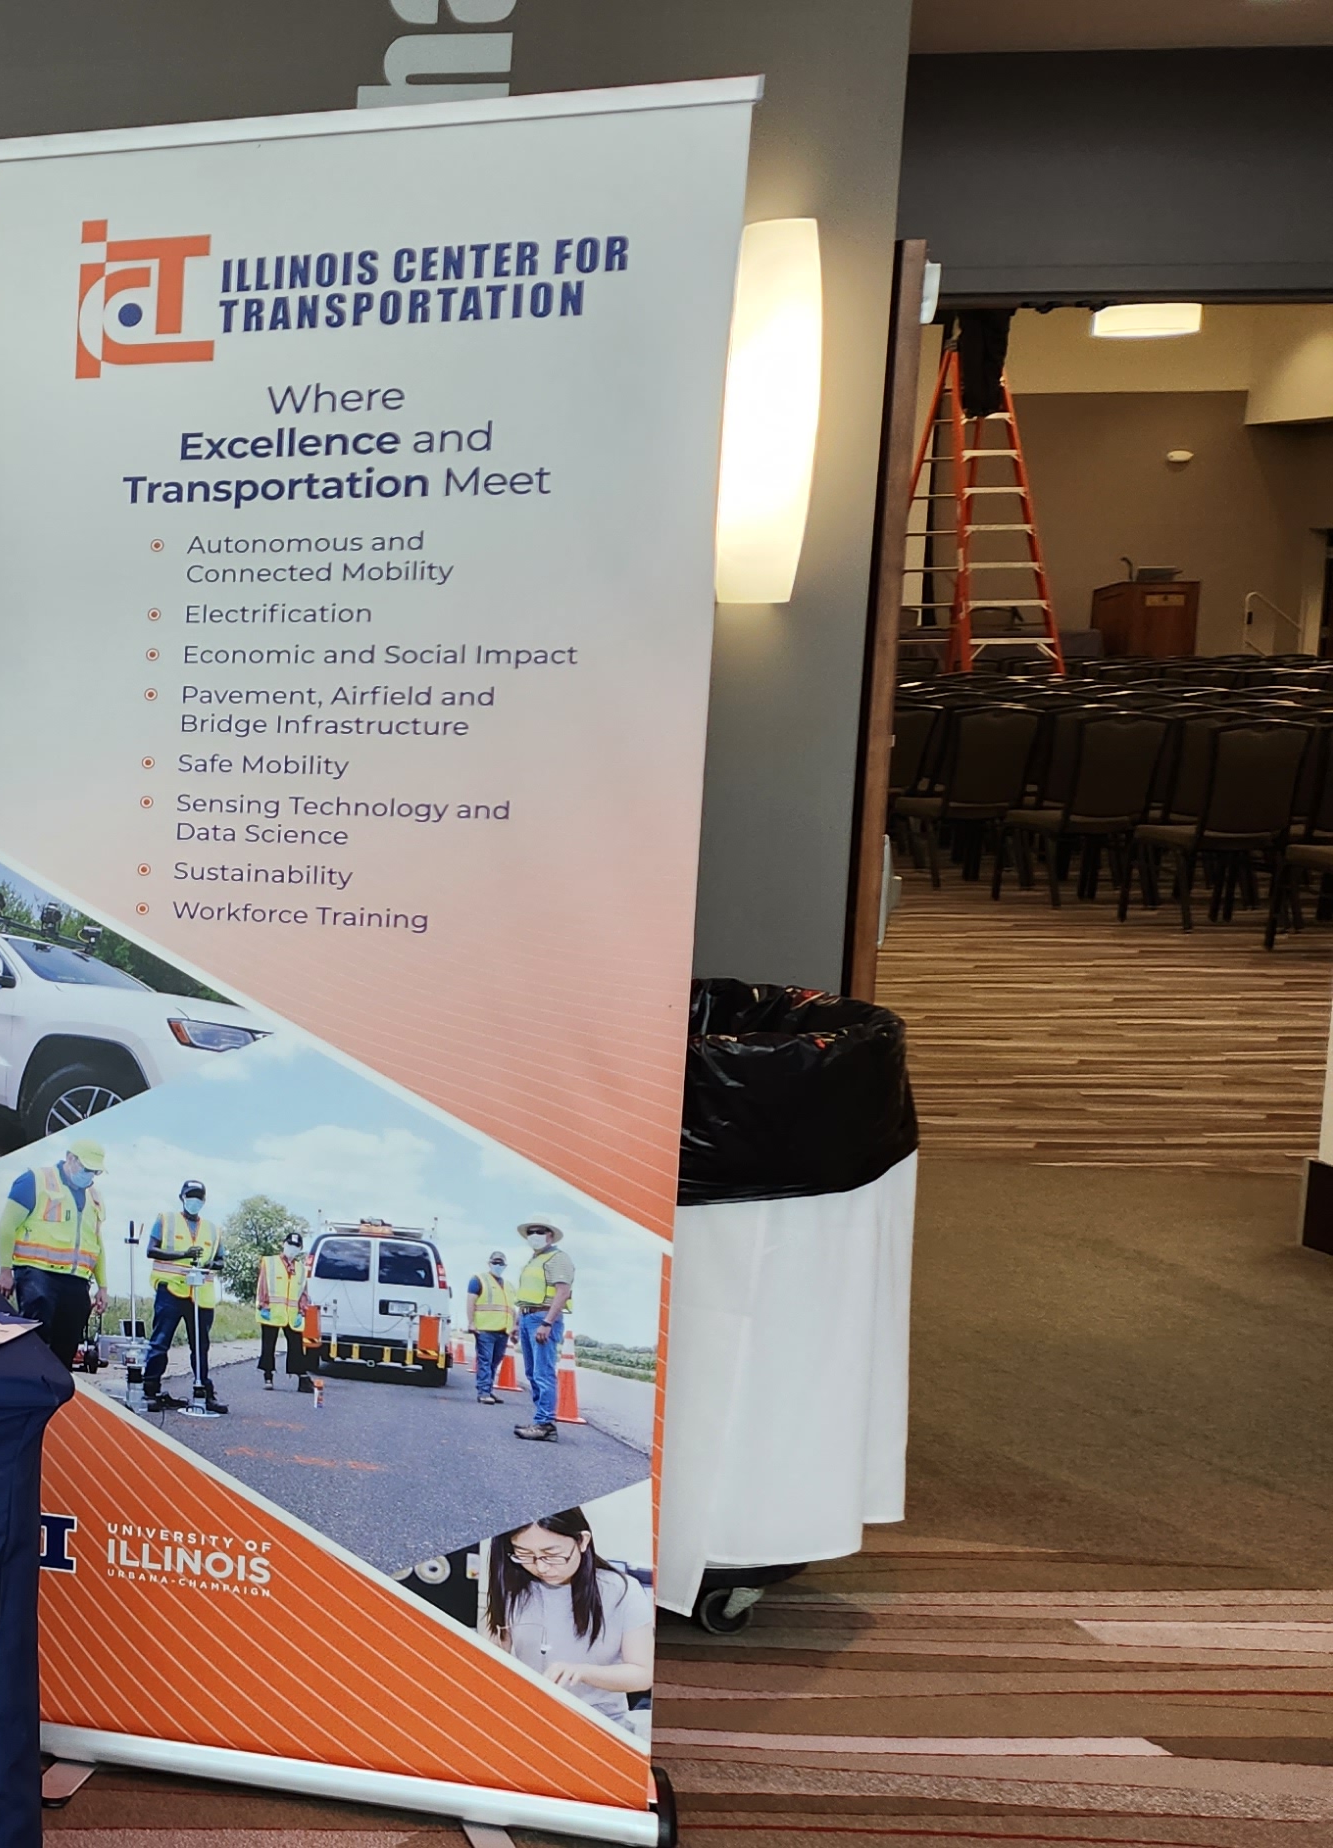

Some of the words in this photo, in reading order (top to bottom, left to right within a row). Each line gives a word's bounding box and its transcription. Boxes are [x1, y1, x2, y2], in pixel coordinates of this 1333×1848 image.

[220, 249, 379, 294] ILLINOIS
[393, 240, 540, 284] CENTER
[554, 235, 629, 274] FOR
[219, 281, 584, 334] TRANSPORTATION
[268, 383, 404, 414] Where
[181, 428, 400, 460] Excellence
[413, 420, 492, 453] and
[123, 467, 428, 509] Transportation
[445, 467, 550, 496] Meet
[187, 536, 362, 554] Autonomous
[372, 531, 423, 551] and
[187, 562, 331, 583] Connected
[343, 561, 453, 585] Mobility
[186, 603, 371, 623] Electrification
[185, 645, 314, 663] Economic
[324, 645, 375, 663] and
[385, 644, 465, 664] Social
[477, 646, 577, 669] Impact
[183, 686, 322, 708] Pavement,
[331, 686, 431, 705] Airfield
[442, 687, 494, 706] and
[182, 714, 266, 737] Bridge
[277, 715, 468, 735] Infrastructure
[179, 754, 232, 772] Safe
[243, 755, 349, 779] Mobility
[177, 794, 279, 818] Sensing
[289, 797, 448, 822] Technology
[457, 801, 509, 819] and
[177, 823, 235, 841] Data
[245, 824, 348, 845] Science
[174, 862, 353, 890] Sustainability
[173, 902, 308, 924] Workforce
[316, 907, 427, 933] Training
[107, 1523, 233, 1549] UNIVERSITY
[245, 1539, 272, 1553] OF
[107, 1539, 271, 1584] ILLINOIS
[107, 1569, 271, 1597] URBANA-CHAMPAIGN
